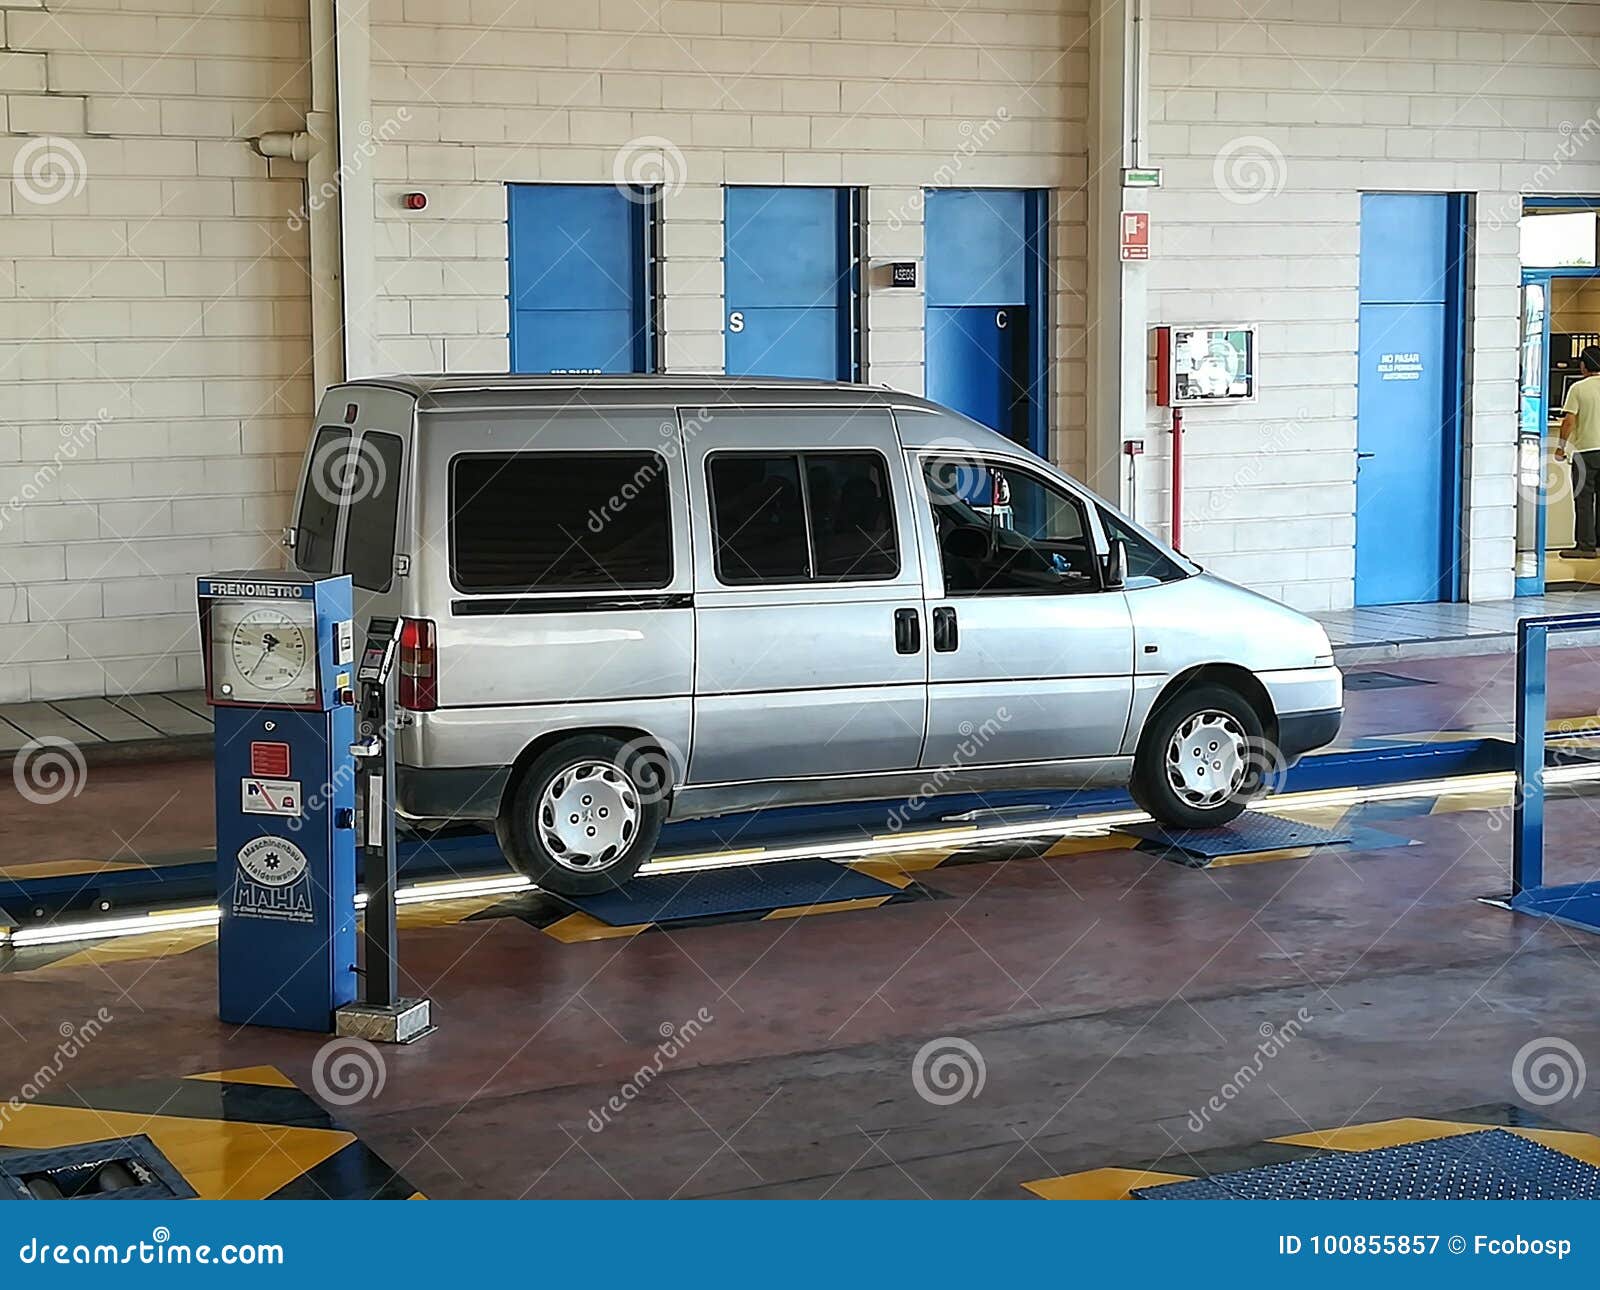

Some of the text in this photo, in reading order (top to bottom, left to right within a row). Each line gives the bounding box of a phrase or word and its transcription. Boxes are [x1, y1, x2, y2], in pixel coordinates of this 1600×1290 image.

[730, 312, 745, 332] S
[996, 310, 1008, 329] C
[209, 583, 303, 598] FRENOMETRO
[243, 839, 300, 861] Maschinenbau
[246, 861, 299, 882] Haldenwang
[233, 867, 313, 912] MAHA
